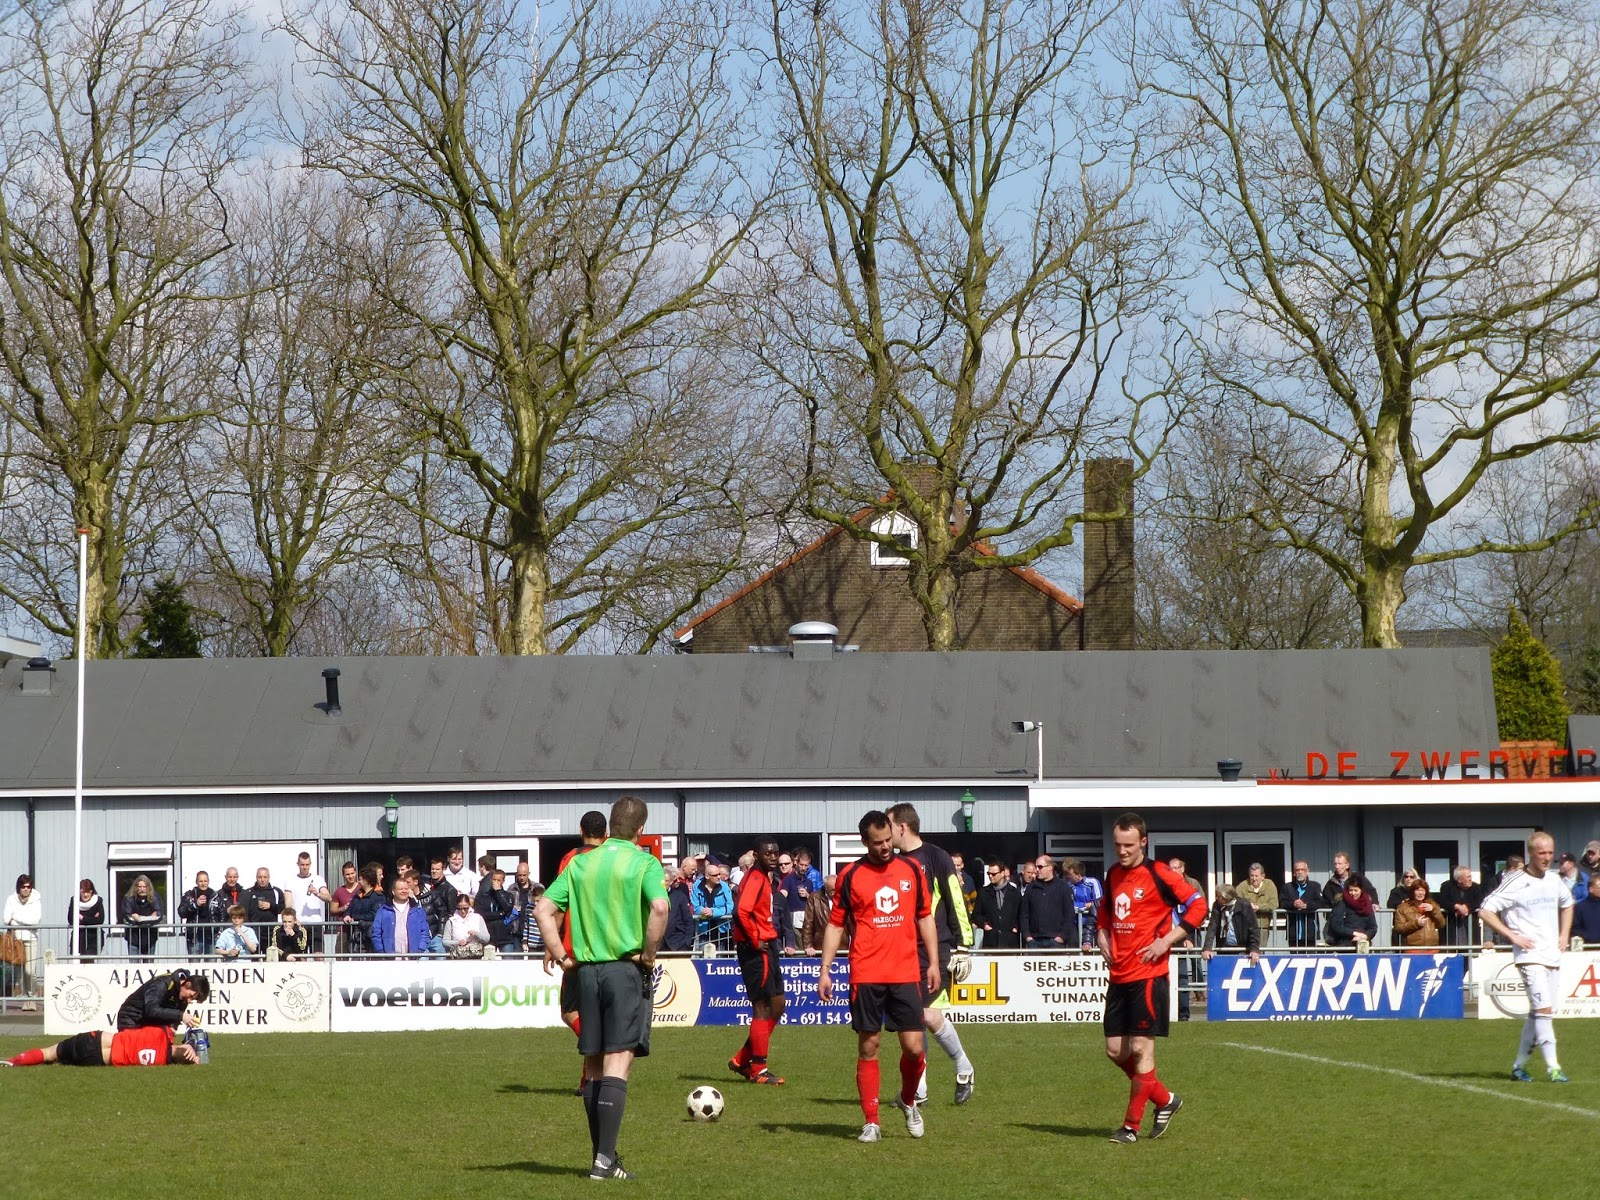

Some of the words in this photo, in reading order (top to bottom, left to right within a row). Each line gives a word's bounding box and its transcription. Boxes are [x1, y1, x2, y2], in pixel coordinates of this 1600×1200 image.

[1306, 751, 1357, 780] DE
[1389, 749, 1597, 780] ZWERVER
[108, 969, 158, 989] AJAX
[273, 972, 295, 998] AJAX
[1036, 976, 1110, 988] SCHUTTIN
[1221, 957, 1411, 1012] EXTRAN
[51, 974, 75, 1001] AJAX
[1491, 983, 1526, 992] NISS
[795, 996, 807, 1007] 17
[801, 1012, 822, 1025] 691
[826, 1012, 841, 1025] 54
[945, 1012, 1037, 1023] Alblasserdam
[1050, 1011, 1071, 1022] tel.
[1076, 1010, 1101, 1022] 078
[1269, 1014, 1313, 1022] SPORTS
